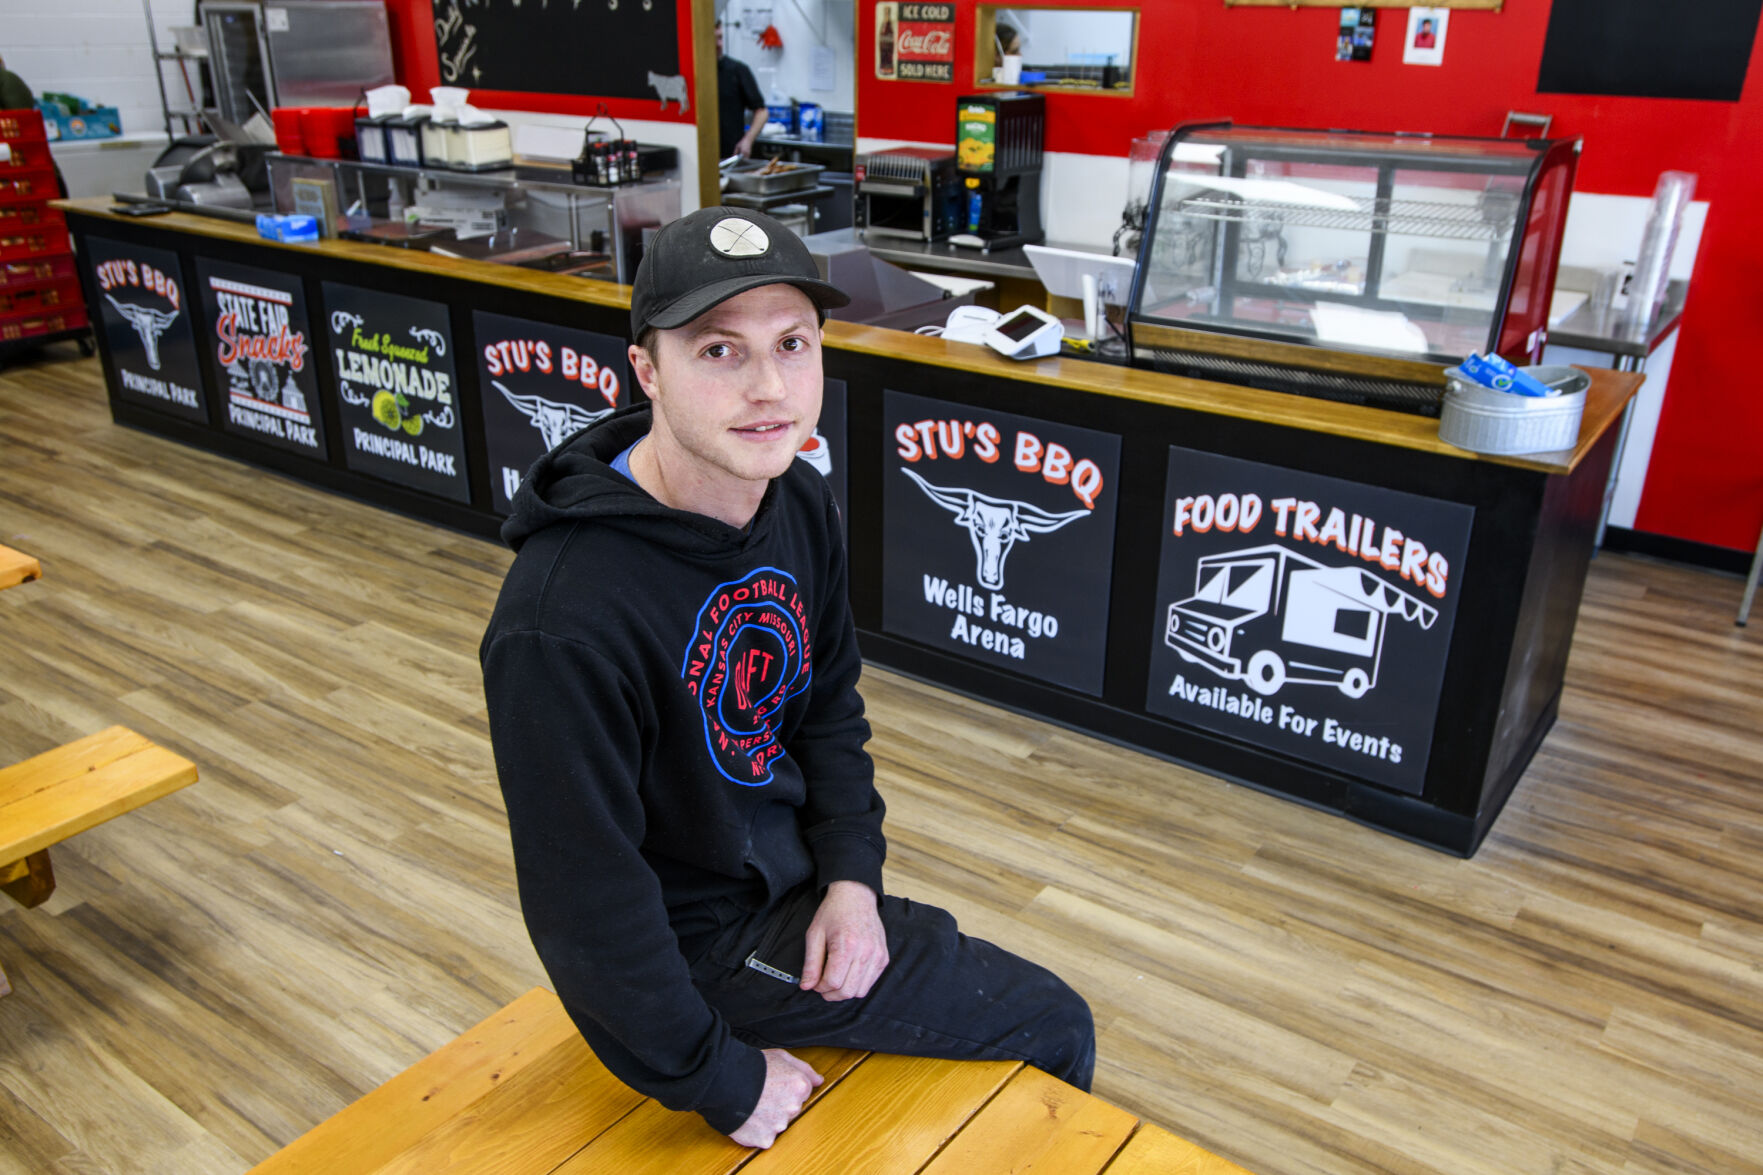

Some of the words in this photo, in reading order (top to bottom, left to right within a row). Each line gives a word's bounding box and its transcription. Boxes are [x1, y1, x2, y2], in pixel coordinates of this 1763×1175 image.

[903, 4, 920, 20] ICE
[921, 5, 950, 20] COLD
[899, 63, 924, 77] SOLD
[924, 63, 950, 79] HERE
[97, 259, 140, 291] STU'S
[141, 263, 180, 310] BBQ
[216, 290, 259, 332] STATE
[258, 300, 292, 339] FAIR
[216, 312, 309, 372] Snacks
[120, 368, 171, 401] PRINCIPAL
[169, 381, 199, 409] PARK
[335, 348, 452, 405] LEMONADE
[484, 339, 553, 376] STU'S
[561, 346, 620, 408] BBQ
[227, 402, 285, 438] PRINCIPAL
[284, 419, 319, 448] PARK
[353, 427, 419, 465] PRINCIPAL
[418, 445, 457, 476] PARK
[895, 419, 1000, 464] STU'S
[1013, 430, 1104, 510] BBQ
[1173, 493, 1262, 537] FOOD
[1270, 497, 1449, 598] TRAILERS
[710, 579, 786, 624] FOOTBALL
[790, 592, 811, 675] LEAGUE
[923, 573, 985, 617] Wells
[990, 592, 1059, 638] Fargo
[706, 638, 729, 708] KANSAS
[729, 612, 754, 636] CITY
[758, 612, 796, 657] MISSOURI
[950, 613, 1026, 660] Arena
[1168, 674, 1273, 725] Available
[1279, 704, 1318, 738] For
[1322, 717, 1403, 764] Events
